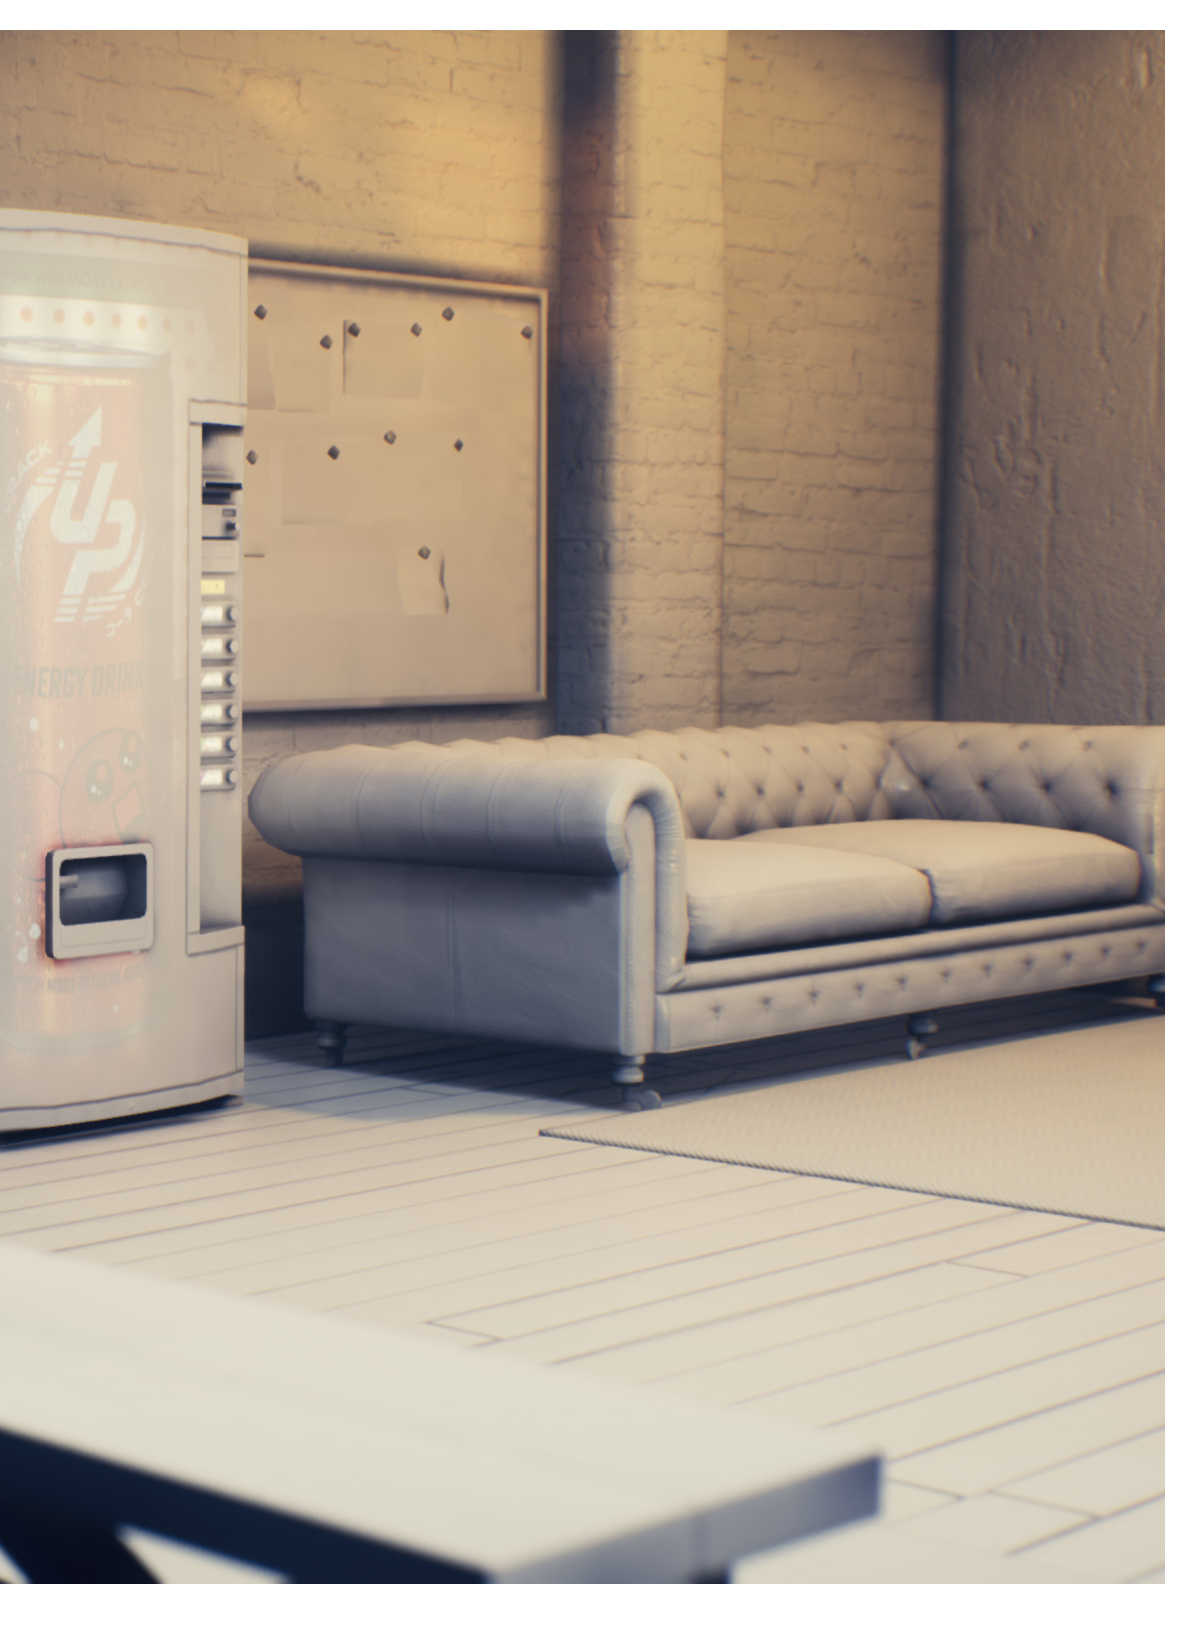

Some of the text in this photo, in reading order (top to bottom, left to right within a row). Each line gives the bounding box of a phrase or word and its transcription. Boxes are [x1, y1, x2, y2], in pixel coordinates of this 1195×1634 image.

[35, 268, 64, 286] with
[67, 271, 107, 289] MORE
[49, 406, 136, 623] UP
[13, 658, 147, 699] ENERGY DRINK
